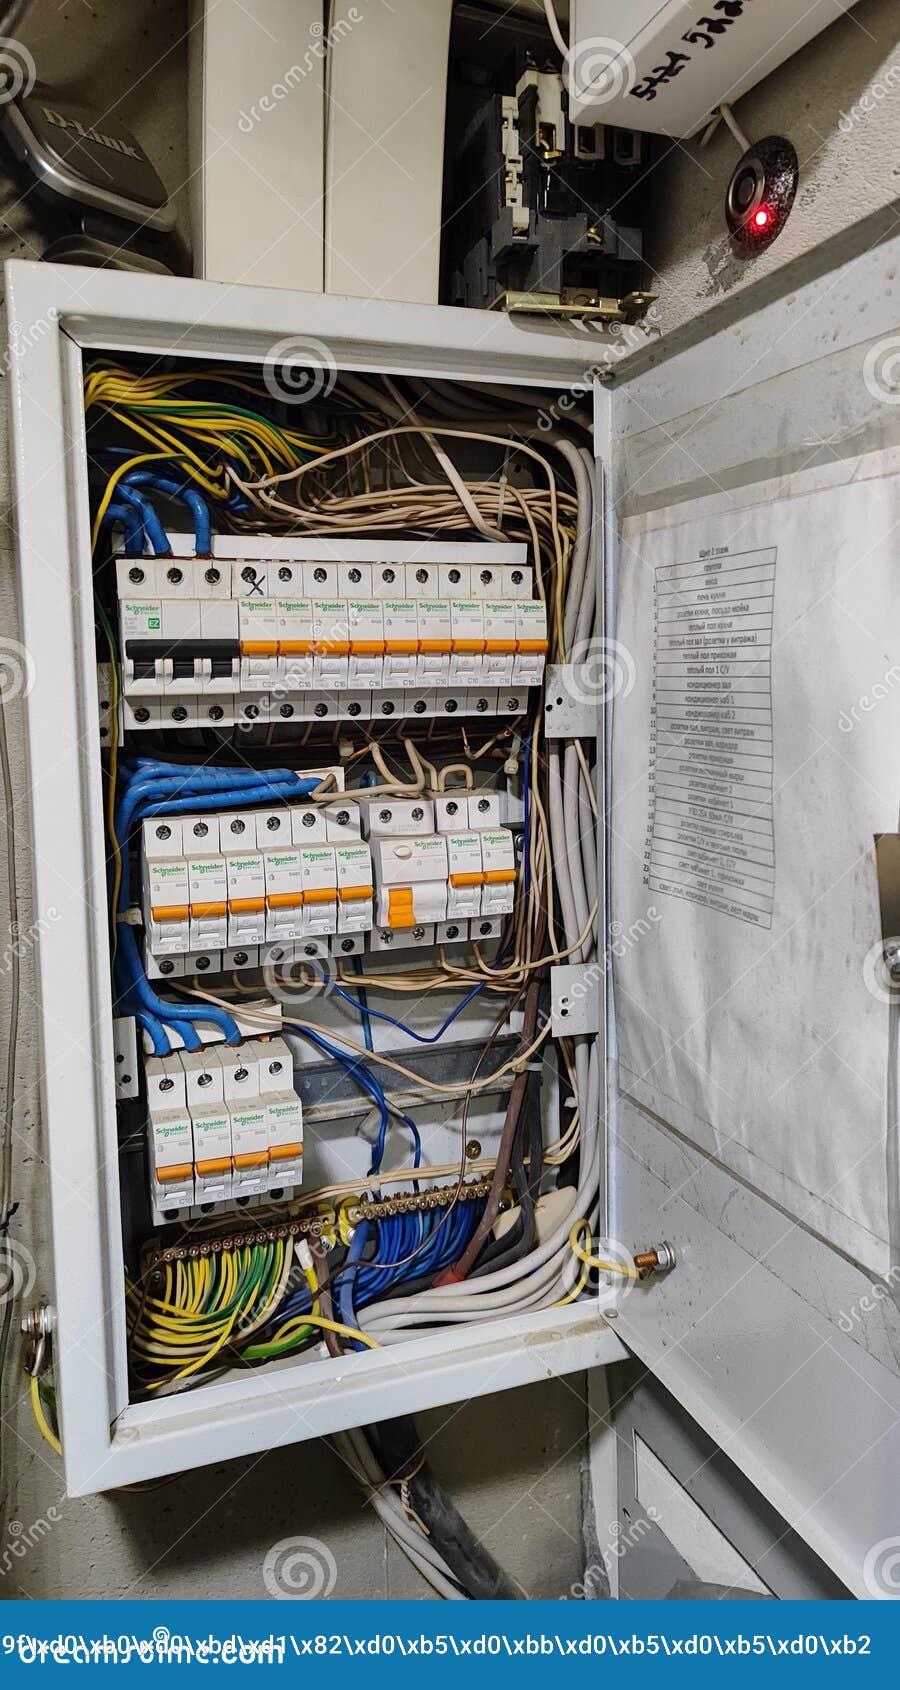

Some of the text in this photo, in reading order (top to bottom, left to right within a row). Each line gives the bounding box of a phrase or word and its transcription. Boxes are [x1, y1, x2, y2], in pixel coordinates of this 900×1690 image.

[41, 106, 145, 162] D-Link
[125, 604, 159, 615] Schneider
[241, 602, 272, 611] Schneider
[279, 602, 308, 612] Schneider
[315, 602, 344, 612] Schneider
[350, 602, 379, 612] Schneider
[386, 603, 414, 612] Schneider
[420, 603, 447, 612] Schneider
[453, 602, 480, 612] Schneider
[486, 604, 512, 612] Schneider
[517, 604, 544, 612] Schneider
[450, 838, 478, 847] Schneider
[483, 836, 510, 844] Schneider
[414, 841, 442, 850] Schneider
[302, 852, 332, 862] Schneider
[338, 850, 368, 859] Schneider
[230, 860, 260, 870] Schneider
[267, 856, 298, 866] Schneider
[152, 866, 185, 877] Schneider
[192, 864, 224, 874] Schneider
[268, 1105, 300, 1117] Schneider
[233, 1114, 264, 1126] Schneider
[156, 1124, 188, 1137] Schneider
[195, 1119, 227, 1132] Schneider
